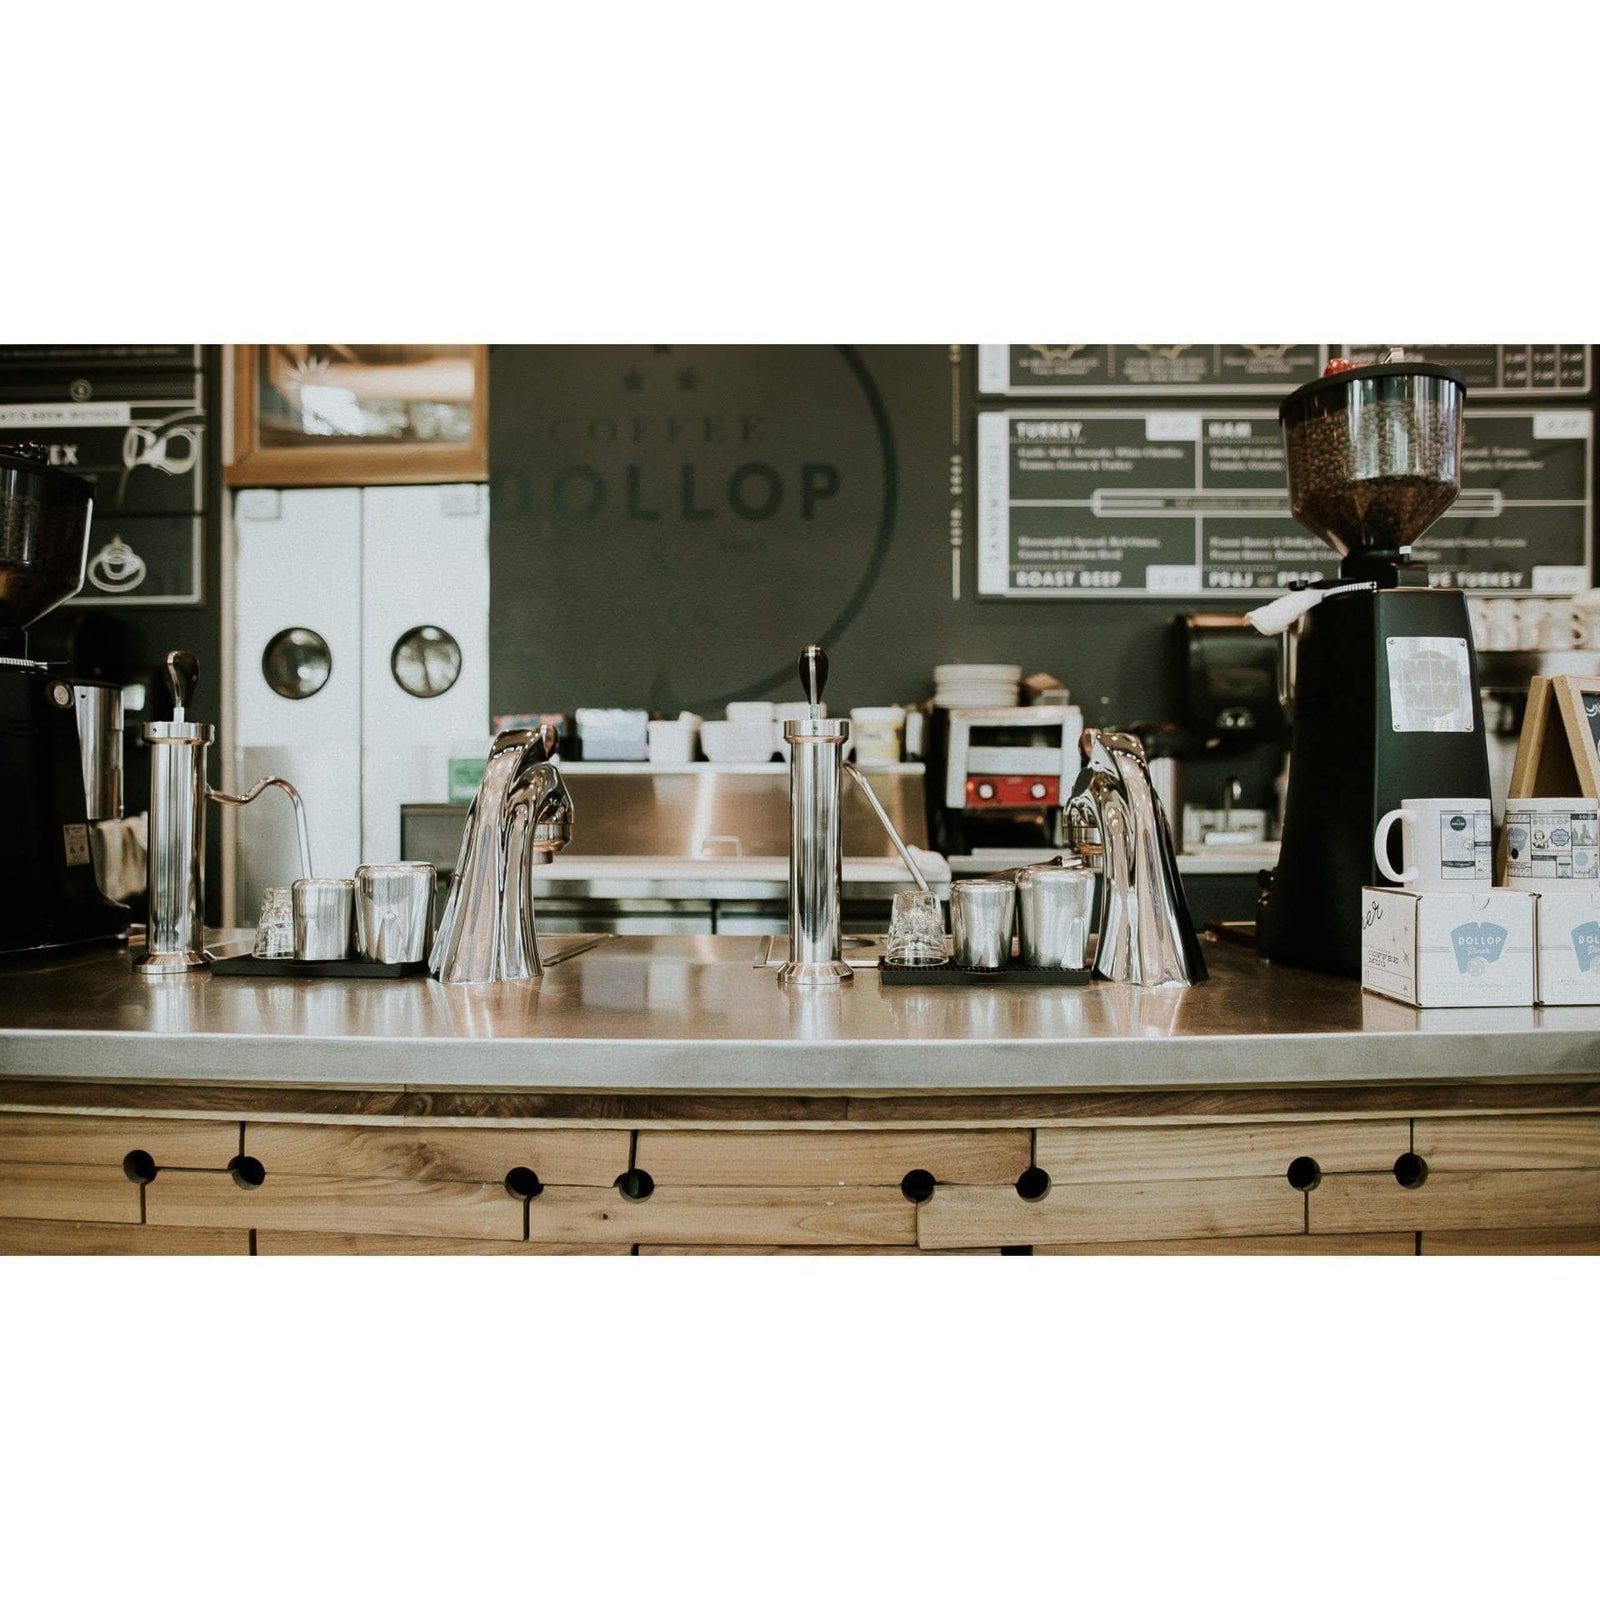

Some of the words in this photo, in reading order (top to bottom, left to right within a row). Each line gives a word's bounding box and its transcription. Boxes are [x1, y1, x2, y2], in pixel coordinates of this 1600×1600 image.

[490, 461, 842, 522] DOLLOP
[1016, 571, 1075, 587] ROAST
[1457, 936, 1502, 946] DOLLOP
[1367, 949, 1399, 964] COFFEE
[1368, 956, 1386, 968] MUG
